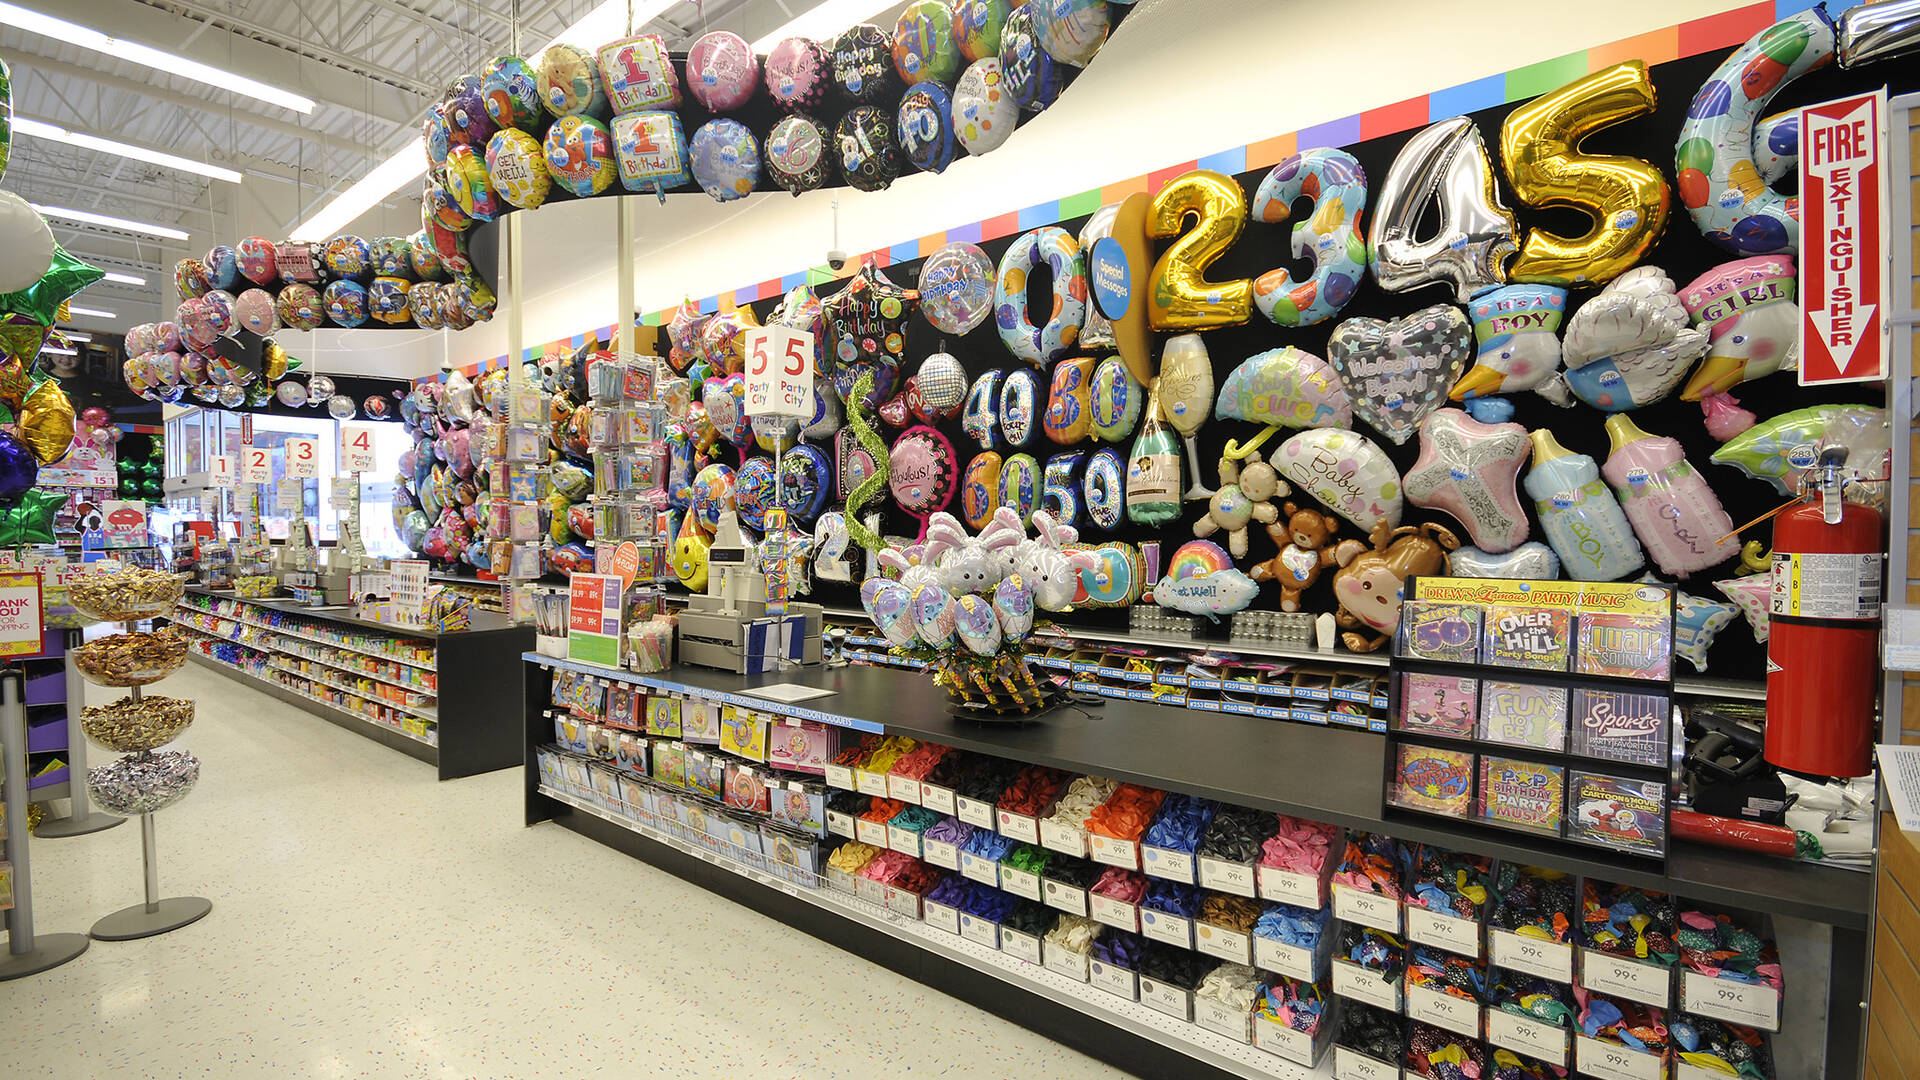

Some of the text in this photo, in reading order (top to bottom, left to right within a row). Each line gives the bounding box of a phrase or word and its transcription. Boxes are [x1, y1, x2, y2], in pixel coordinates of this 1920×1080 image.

[618, 46, 650, 86] 1
[618, 83, 669, 106] Birthday!
[631, 120, 659, 155] 1
[1813, 120, 1867, 166] FIRE
[498, 155, 517, 168] GET
[625, 156, 675, 174] Birthday!
[497, 165, 528, 182] WELL!
[1502, 59, 1670, 289] 5
[1369, 115, 1520, 303] 4
[1252, 147, 1368, 327] 3
[1148, 169, 1254, 332] 2
[1829, 167, 1852, 347] EXTINGUISHER
[1100, 259, 1124, 280] Special
[1749, 268, 1765, 281] A
[1096, 272, 1128, 298] Messages
[840, 297, 877, 319] Happy
[1702, 281, 1786, 322] GIRL
[836, 318, 886, 338] Birthday
[1491, 311, 1550, 334] BOY
[751, 336, 768, 376] 5
[784, 338, 805, 376] 5
[749, 382, 770, 395] Party
[781, 380, 807, 397] Party
[1252, 373, 1293, 396] Baby
[751, 393, 767, 406] City
[784, 393, 803, 408] City
[962, 369, 1034, 450] 40
[298, 442, 313, 459] 3
[352, 431, 370, 451] 4
[218, 459, 226, 472] 1
[252, 451, 266, 467] 2
[296, 462, 315, 471] Party
[351, 453, 372, 464] Party
[354, 459, 369, 467] City
[1311, 445, 1366, 505] Baby
[1289, 462, 1362, 523] Shower
[1659, 504, 1704, 554] GIRL
[1571, 522, 1604, 569] BOY
[1793, 561, 1799, 569] A
[1793, 581, 1798, 589] B
[1425, 586, 1627, 608] DREW'S Famous PARTY MUSIC
[1793, 601, 1798, 609] C
[1499, 612, 1552, 632] OVER
[1529, 627, 1547, 635] the
[1416, 618, 1471, 652] 50
[1496, 649, 1556, 663] Party Songs
[1601, 652, 1651, 668] SOUNDS
[1496, 693, 1556, 717] FUN
[796, 708, 821, 721] BALLOON
[822, 712, 852, 727] BOUQUETS
[1509, 714, 1526, 726] TO
[1584, 703, 1661, 733] Sports
[1503, 724, 1525, 739] BE
[1589, 737, 1653, 750] PARTY FAVORITES
[1501, 769, 1548, 788] POP
[1494, 782, 1552, 799] BIRTHDAY
[1582, 790, 1624, 802] CARTOON
[1497, 792, 1551, 811] PARTY
[1497, 807, 1548, 824] MUSIC
